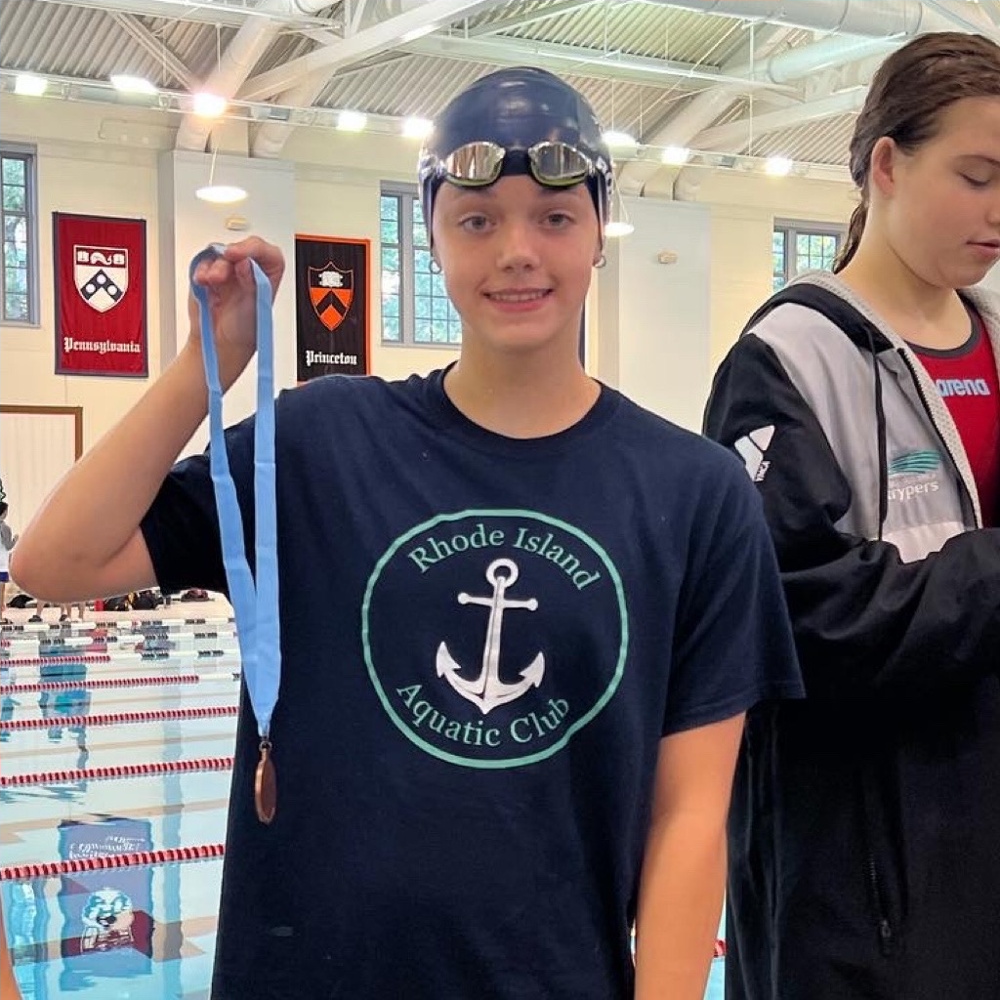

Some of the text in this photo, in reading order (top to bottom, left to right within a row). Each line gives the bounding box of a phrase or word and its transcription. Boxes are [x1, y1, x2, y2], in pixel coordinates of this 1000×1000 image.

[63, 336, 141, 355] Pennsylvania
[305, 349, 358, 367] Princeton
[936, 378, 991, 397] arena
[407, 523, 601, 591] Rhode Island
[396, 683, 571, 747] Aquatic Club
